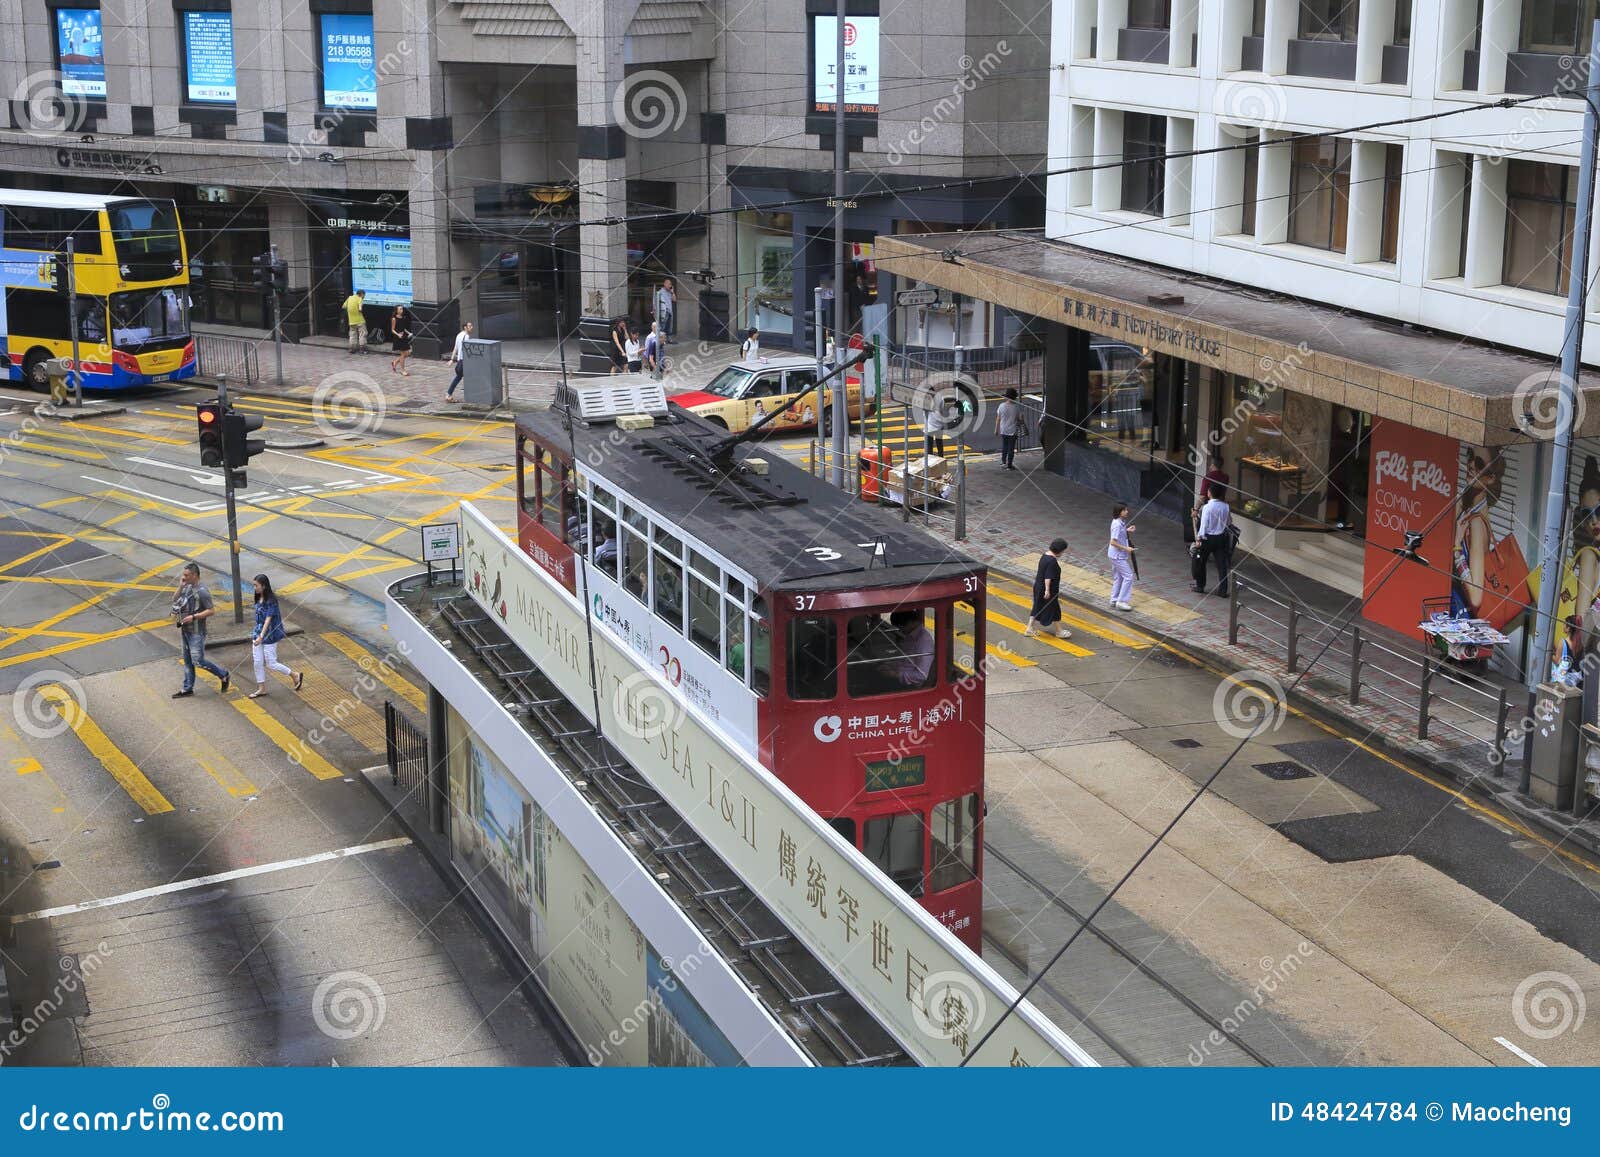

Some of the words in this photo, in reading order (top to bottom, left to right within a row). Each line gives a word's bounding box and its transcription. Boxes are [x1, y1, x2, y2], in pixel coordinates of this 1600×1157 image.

[327, 46, 344, 57] 218
[345, 46, 372, 57] 95588
[1124, 313, 1149, 336] NEW
[1150, 318, 1184, 347] HENRY
[1185, 329, 1221, 357] HOUSE
[1375, 450, 1409, 485] Folli
[1411, 460, 1451, 497] Follie
[1375, 489, 1421, 518] COMING
[1374, 508, 1409, 534] SOON
[963, 576, 978, 592] 37
[795, 595, 816, 611] 37
[659, 645, 682, 687] 30
[516, 583, 581, 677] MAYFAIR
[613, 674, 650, 745] THE
[660, 720, 695, 789] SEA
[848, 731, 885, 740] CHINA
[888, 725, 913, 736] LIFE
